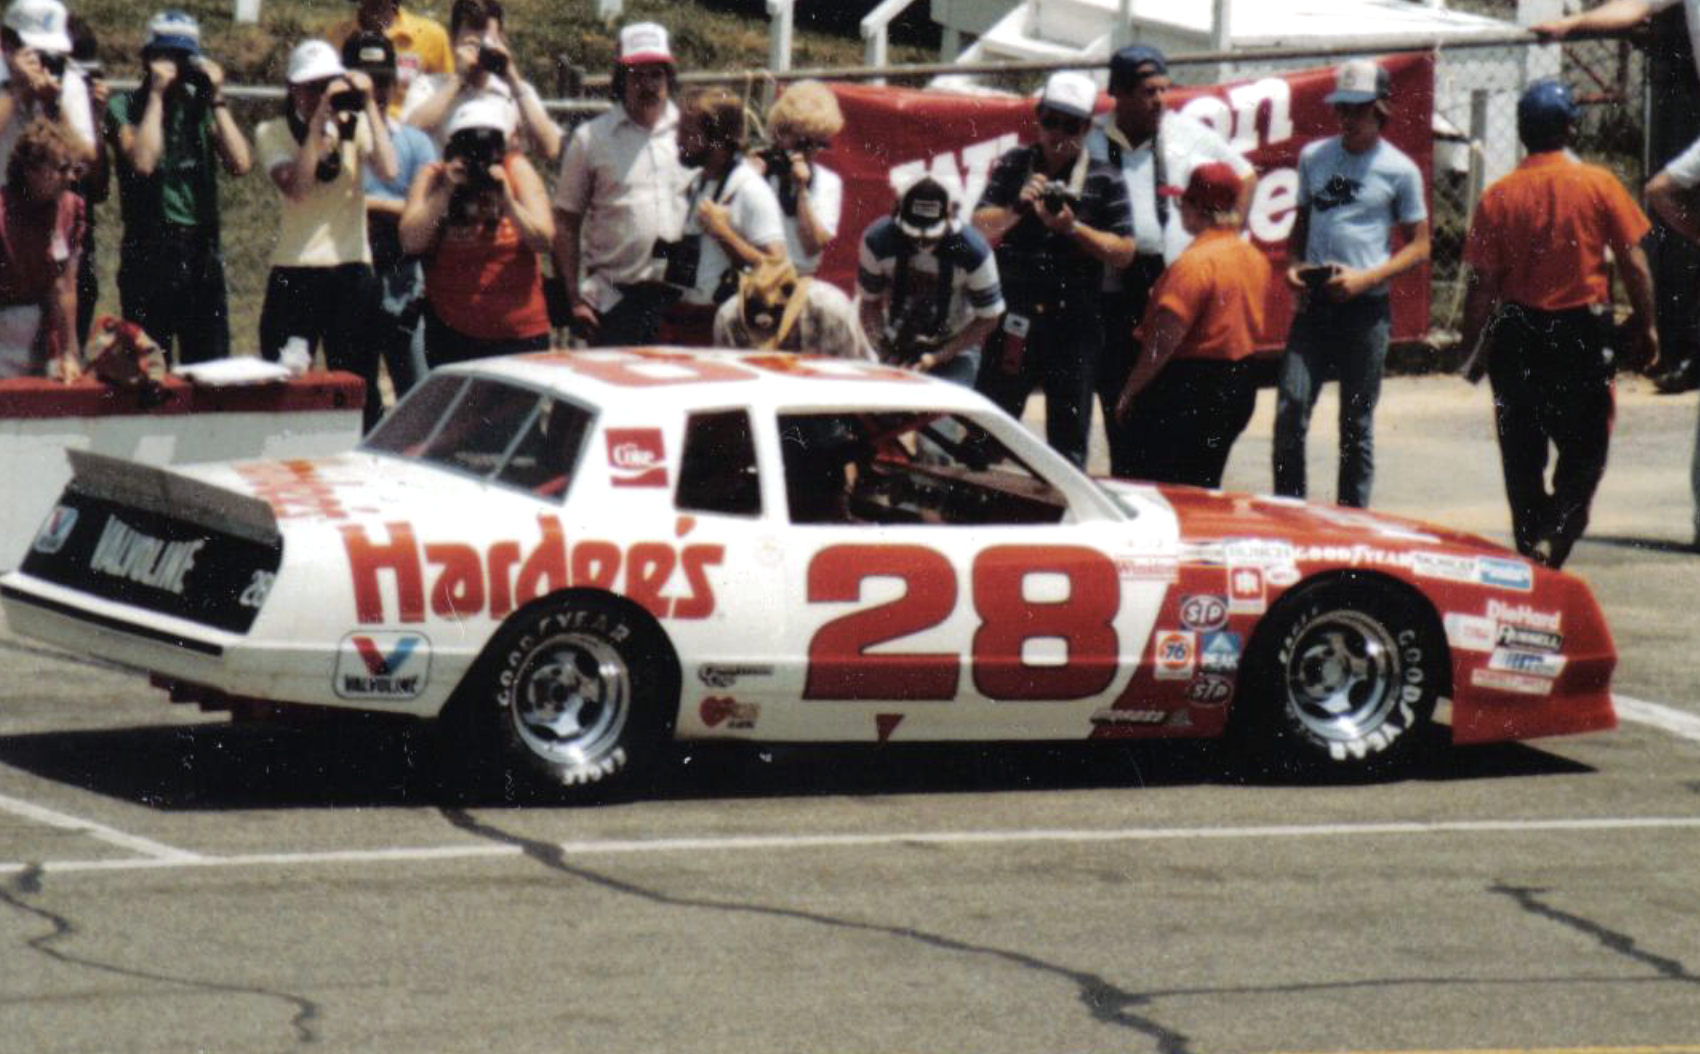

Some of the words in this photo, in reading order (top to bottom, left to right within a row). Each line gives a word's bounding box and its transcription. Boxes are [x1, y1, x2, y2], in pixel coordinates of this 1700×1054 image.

[336, 514, 726, 625] Hardee's
[802, 543, 1120, 701] 28
[1185, 600, 1223, 623] STP
[1165, 642, 1186, 660] 76
[343, 673, 420, 694] VALVOLINE
[1192, 678, 1229, 700] STP
